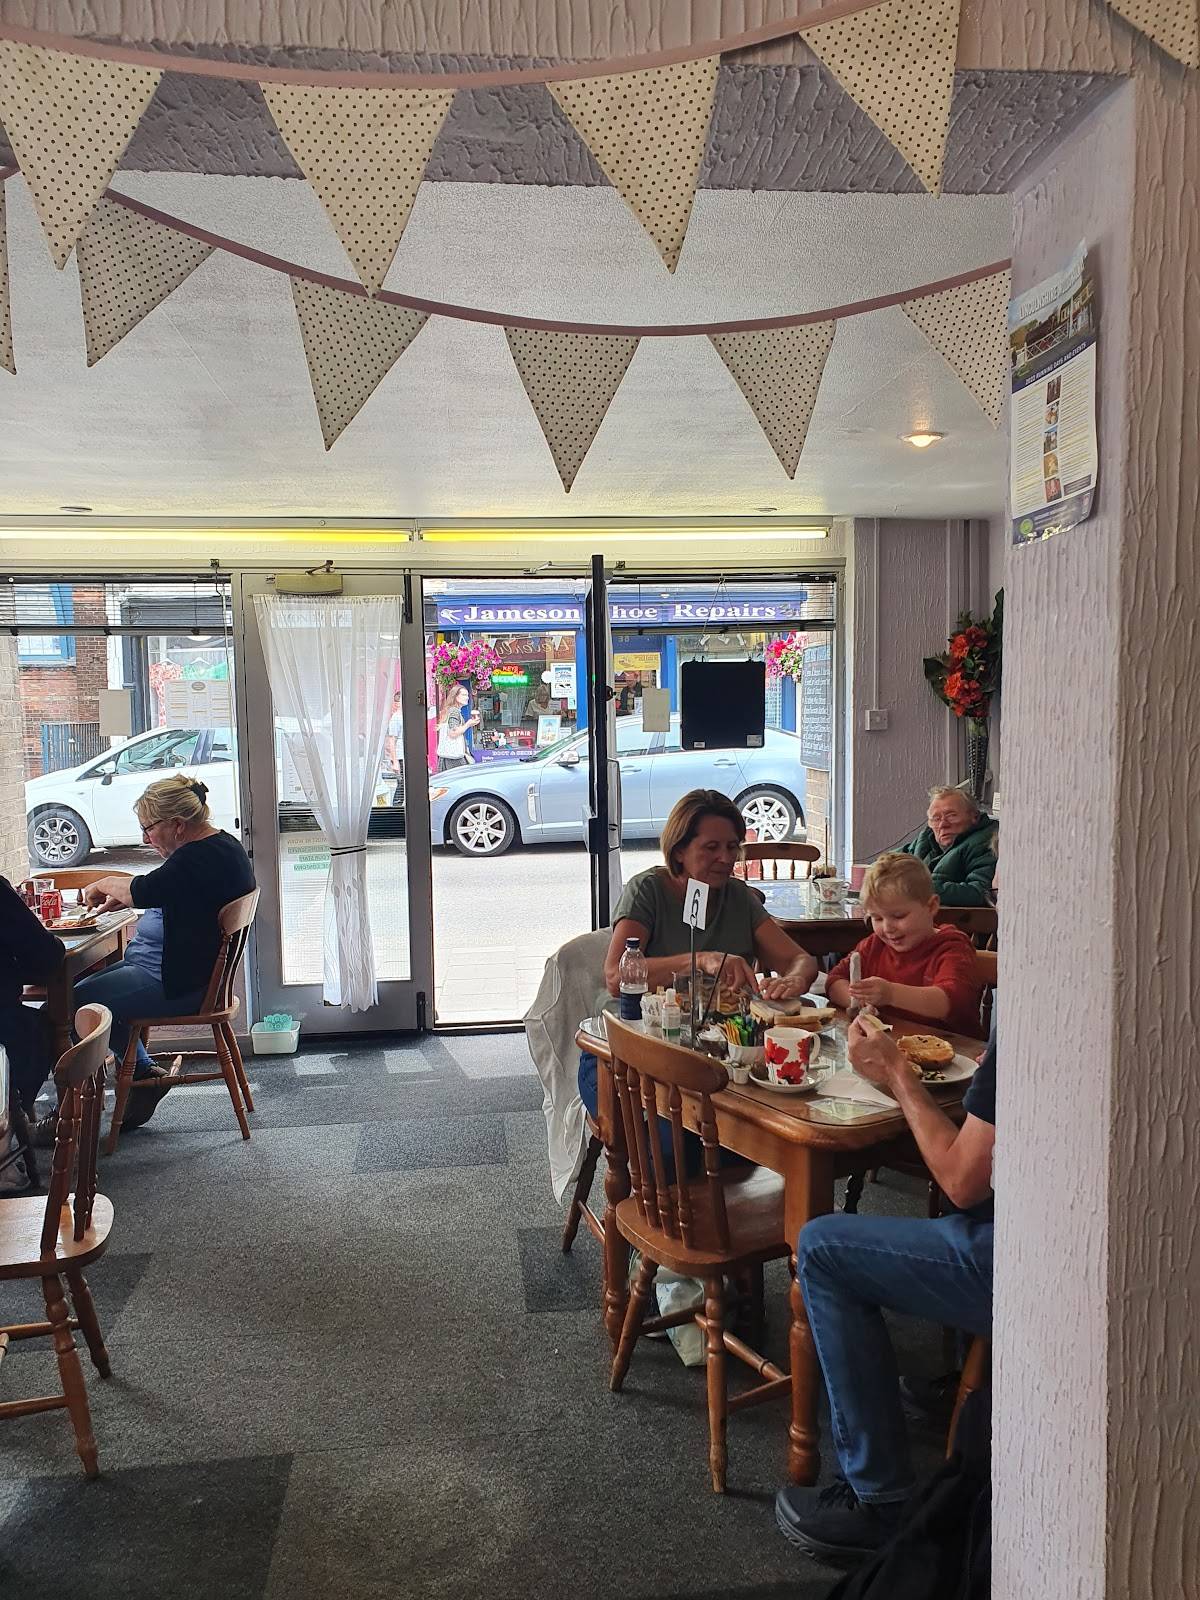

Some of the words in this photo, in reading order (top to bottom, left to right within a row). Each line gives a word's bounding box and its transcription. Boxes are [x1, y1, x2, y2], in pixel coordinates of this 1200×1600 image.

[1035, 364, 1053, 379] RUNNING
[463, 606, 581, 621] Jameson
[611, 604, 658, 619] hoe
[673, 603, 777, 621] Repairs
[691, 888, 701, 920] 6
